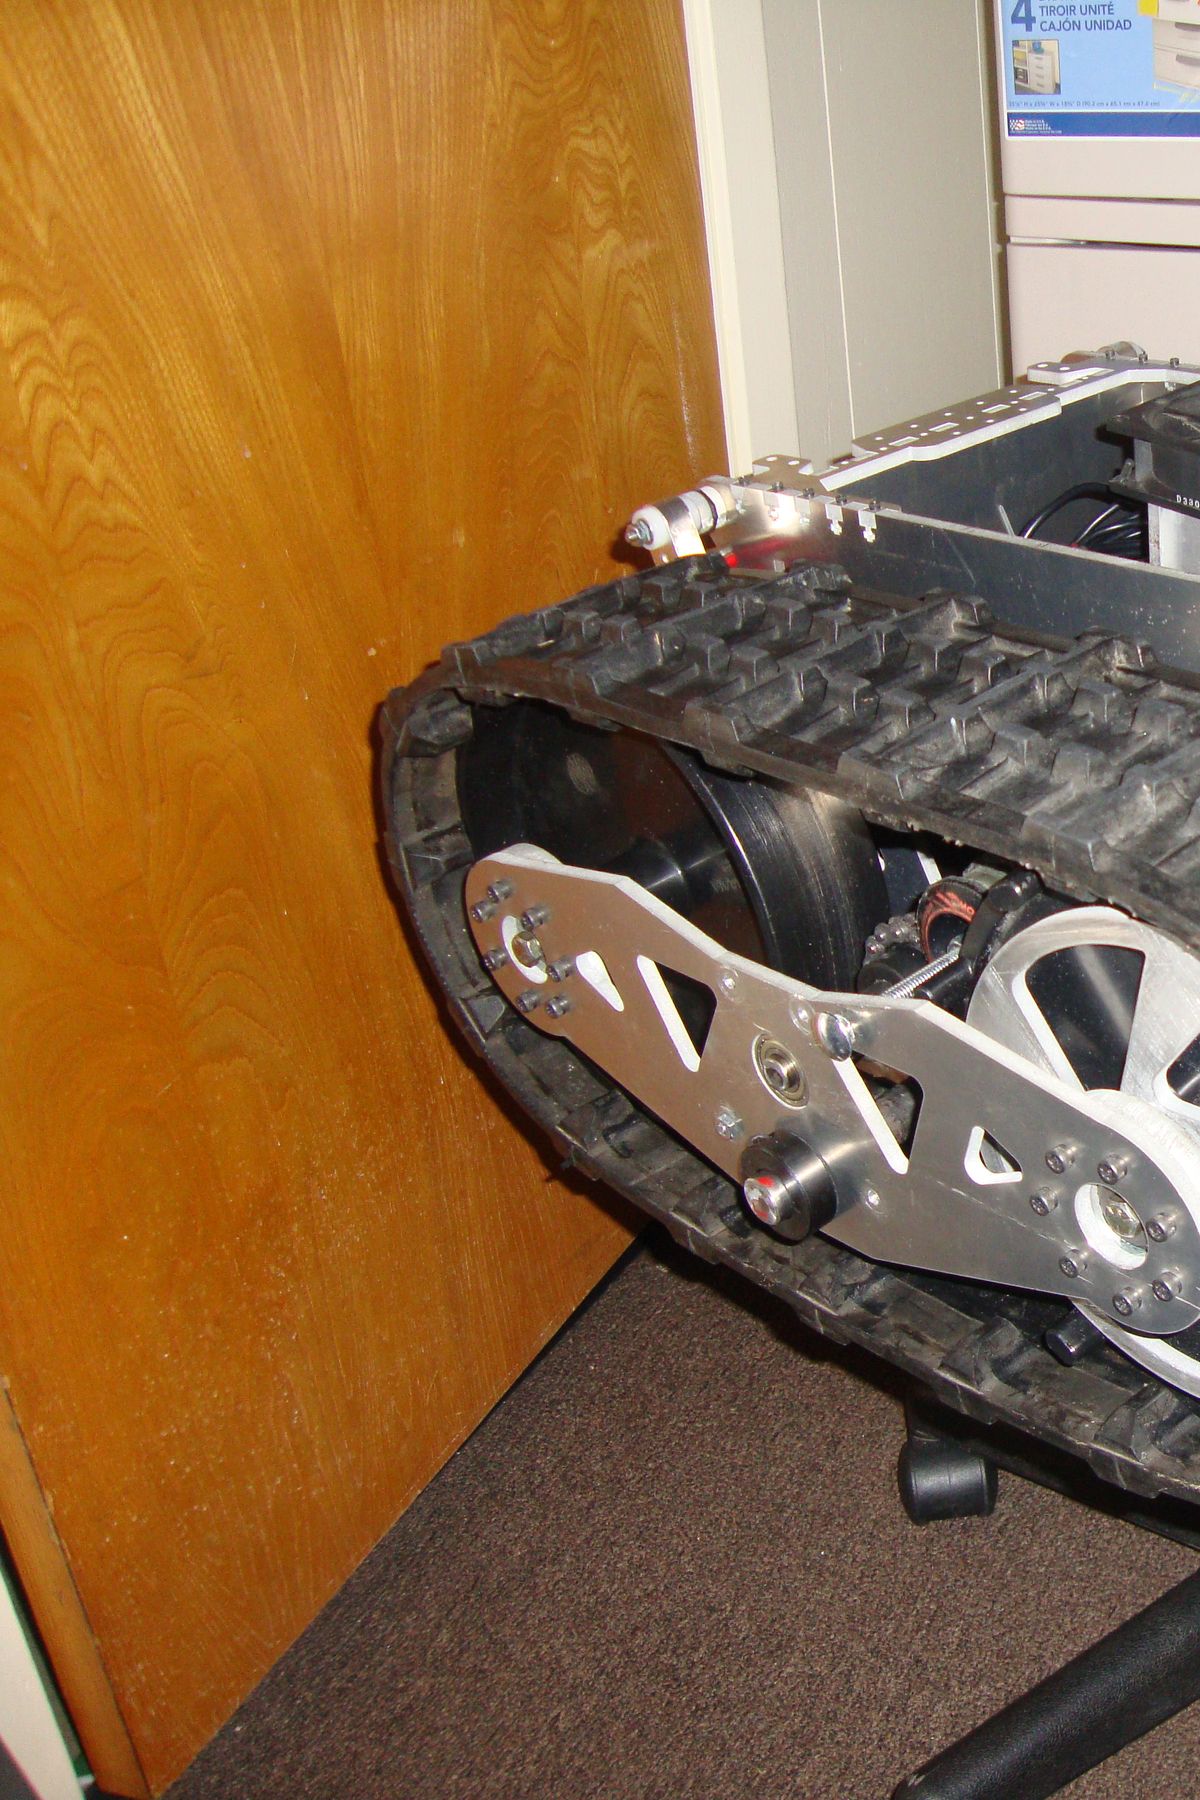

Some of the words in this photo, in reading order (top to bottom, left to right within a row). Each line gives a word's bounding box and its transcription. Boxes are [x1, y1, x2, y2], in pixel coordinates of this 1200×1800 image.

[1011, 0, 1036, 32] 4
[1039, 5, 1076, 16] TIROIR
[1080, 2, 1114, 16] UNITÉ
[1040, 18, 1081, 32] CAJÓN
[1085, 19, 1132, 31] UNIDAD
